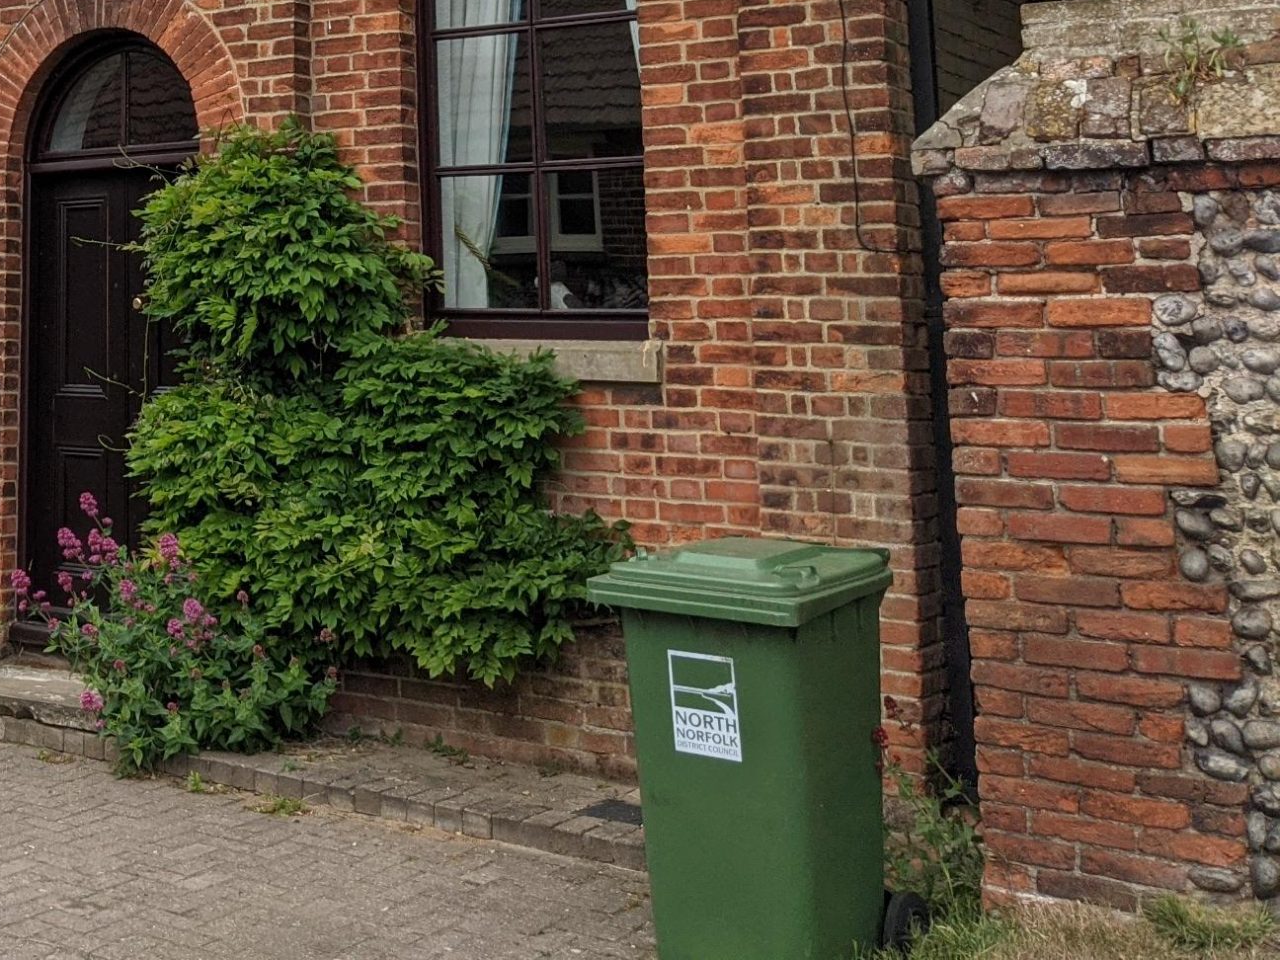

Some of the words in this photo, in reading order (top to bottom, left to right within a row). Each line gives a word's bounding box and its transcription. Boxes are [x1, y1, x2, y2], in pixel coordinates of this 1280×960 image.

[675, 710, 737, 733] NORTH
[677, 727, 738, 748] NORFOLK
[677, 740, 706, 751] DISTRICT
[708, 745, 739, 757] COUNCIL
